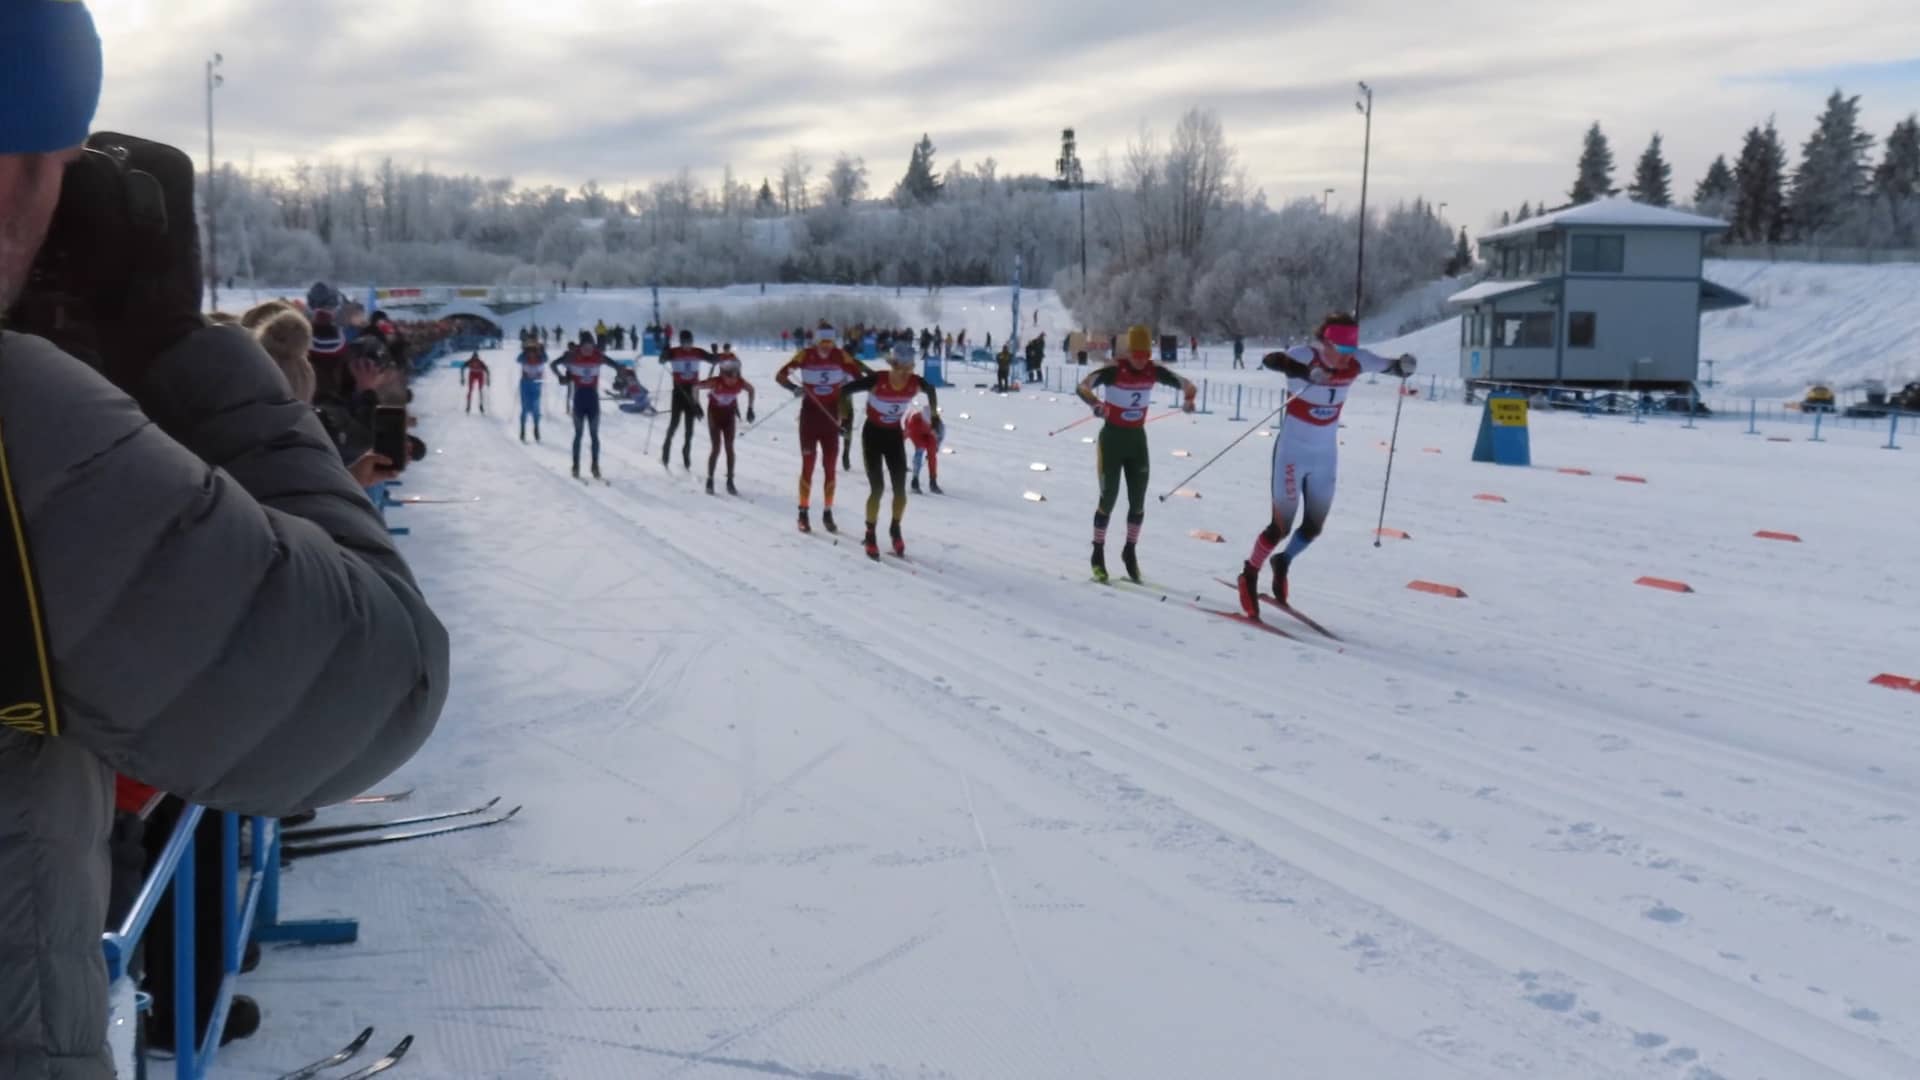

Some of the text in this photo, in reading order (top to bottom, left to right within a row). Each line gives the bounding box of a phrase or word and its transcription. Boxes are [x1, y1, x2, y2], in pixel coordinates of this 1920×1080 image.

[820, 372, 829, 384] 5
[1130, 392, 1142, 407] 2
[1328, 388, 1336, 404] 1
